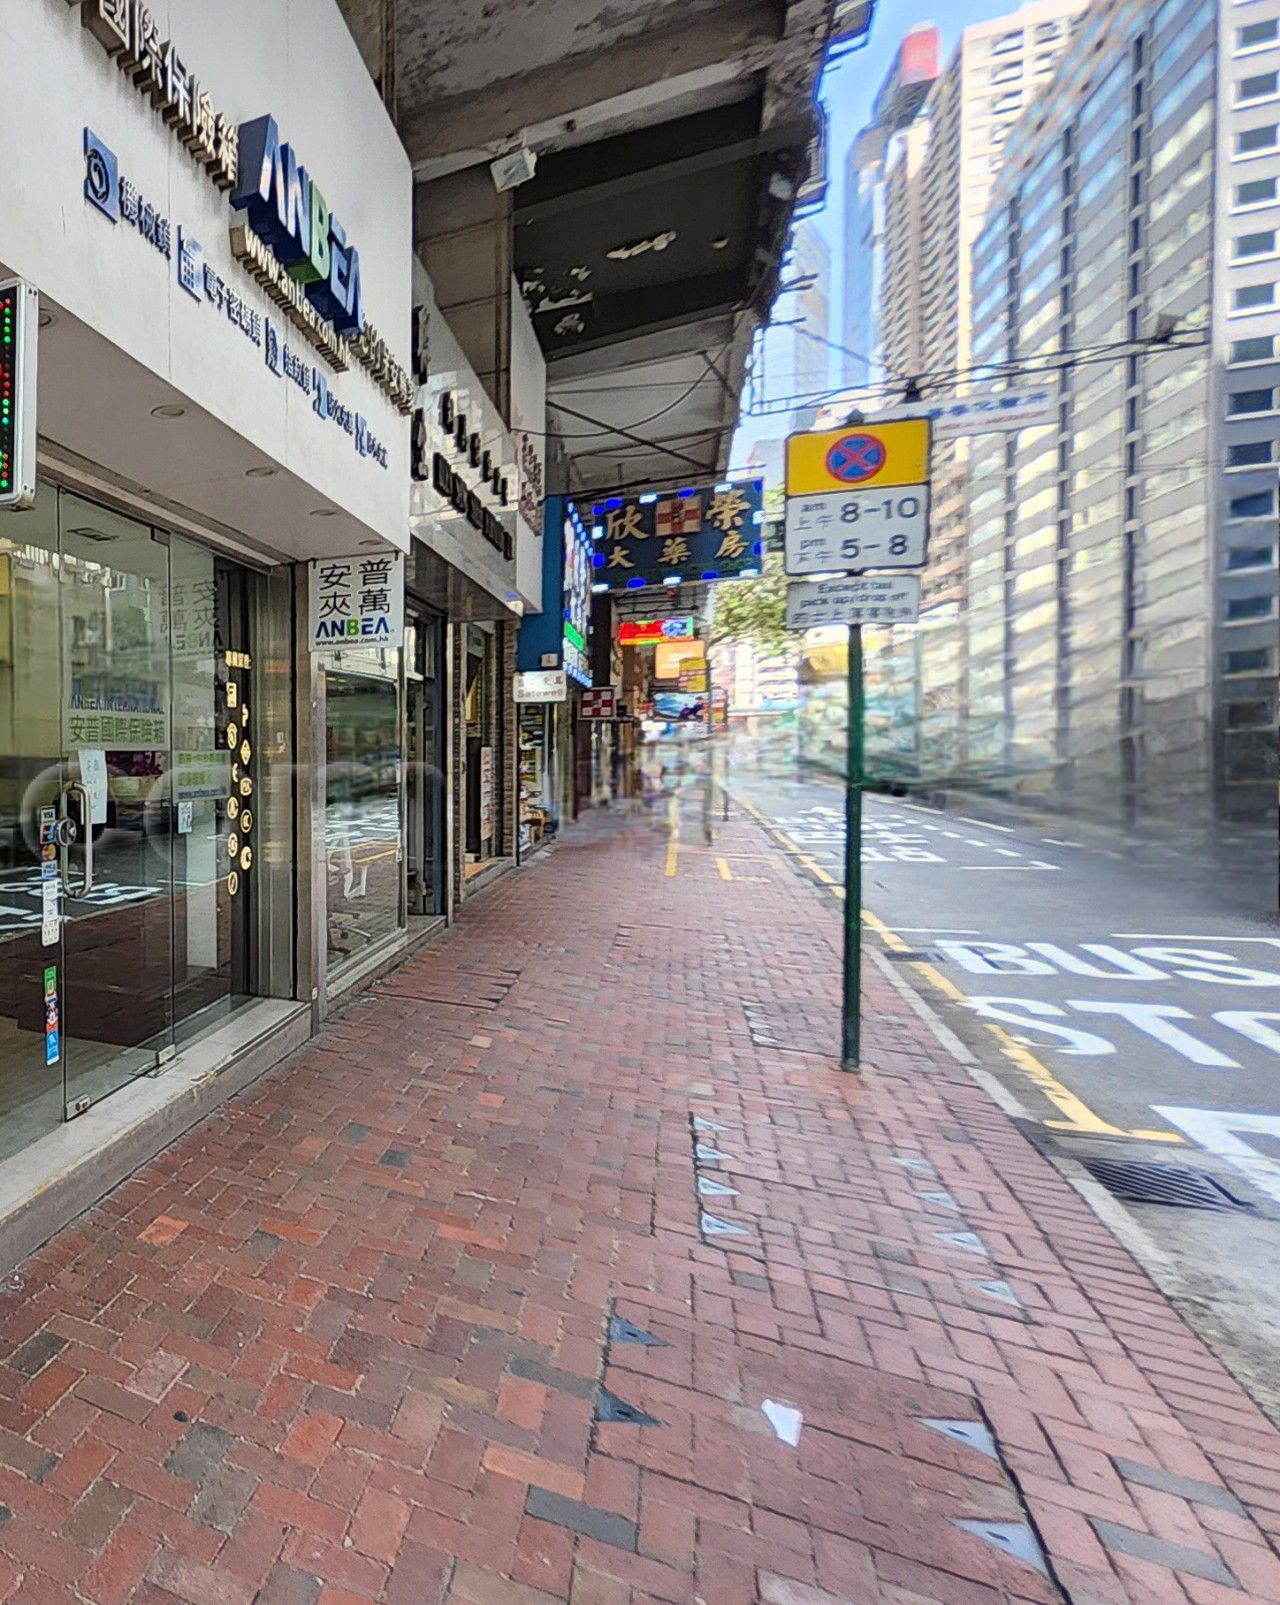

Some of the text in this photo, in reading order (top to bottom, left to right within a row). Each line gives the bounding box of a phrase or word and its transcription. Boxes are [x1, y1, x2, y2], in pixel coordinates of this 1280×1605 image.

[840, 497, 920, 524] 8-10
[319, 558, 393, 590] 安普
[319, 588, 393, 619] 夾萬
[316, 617, 390, 638] ANBEA
[933, 939, 1280, 987] BUS
